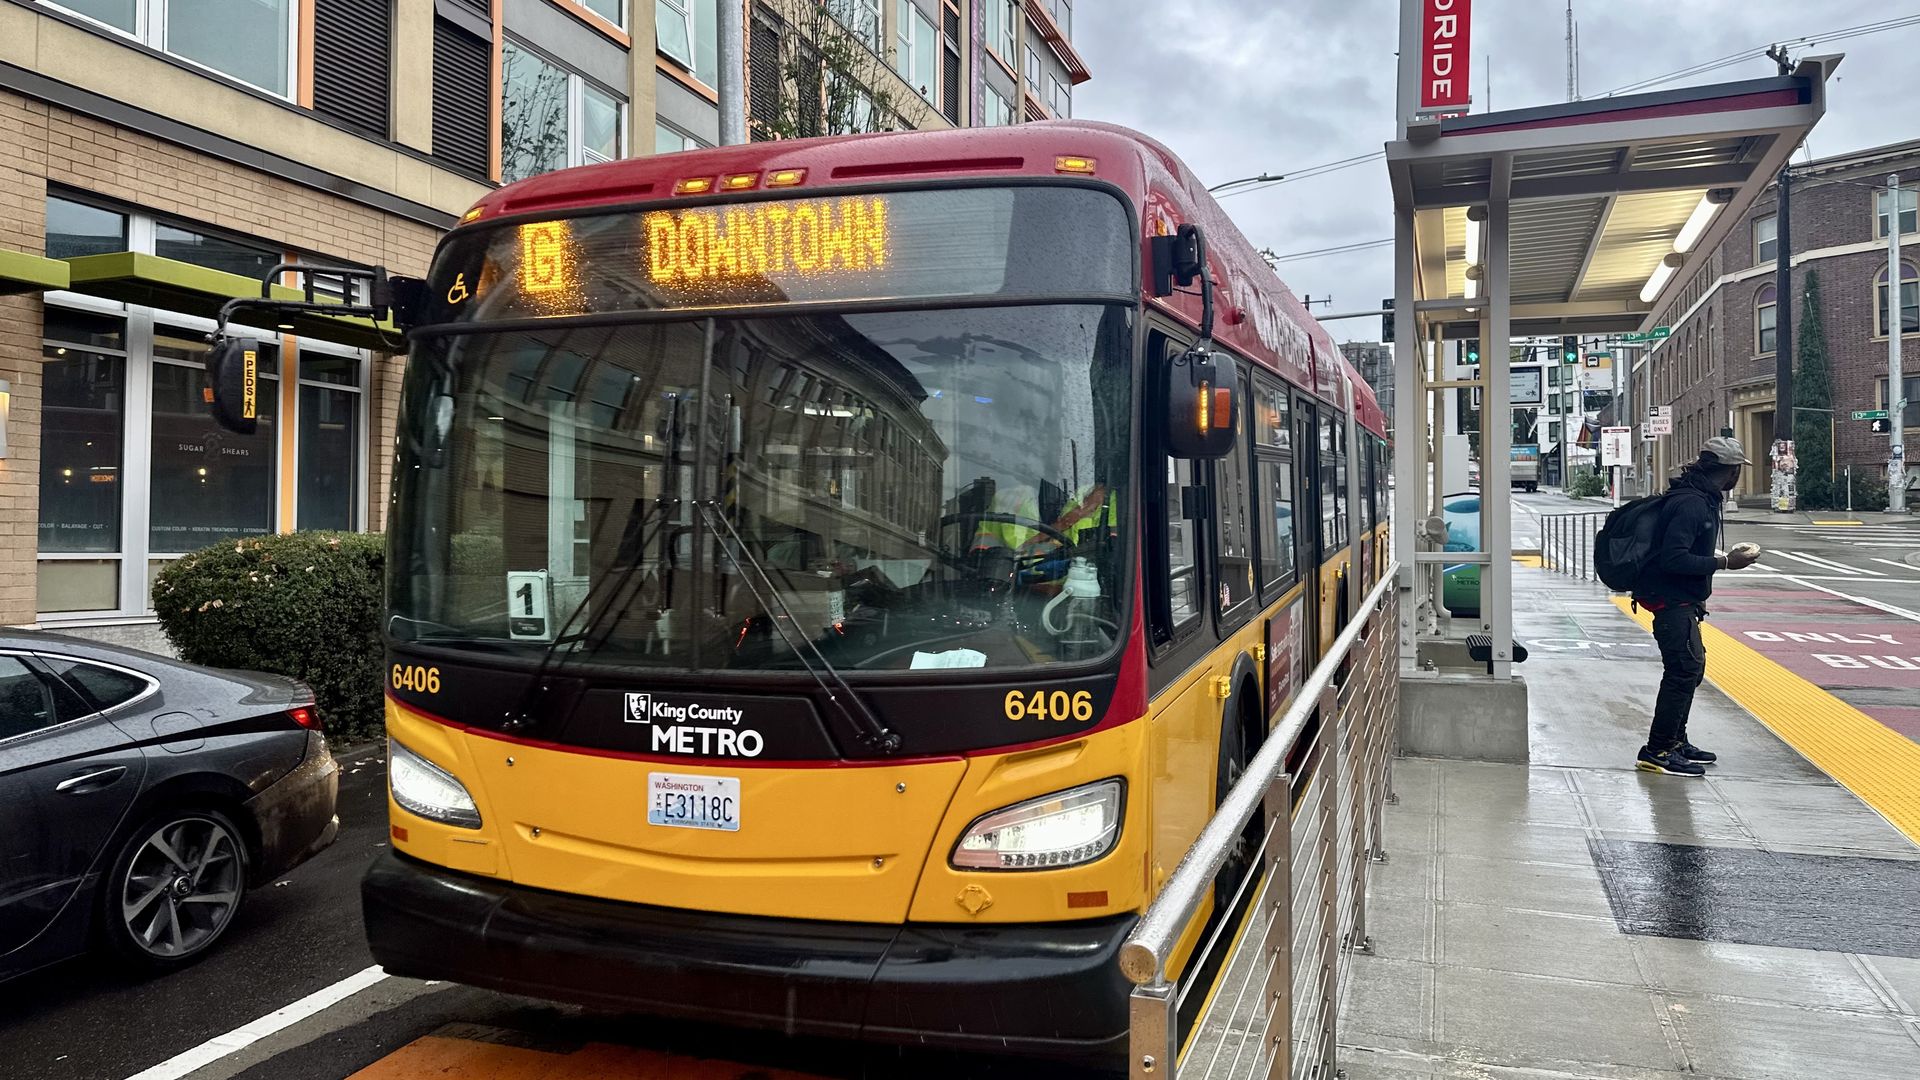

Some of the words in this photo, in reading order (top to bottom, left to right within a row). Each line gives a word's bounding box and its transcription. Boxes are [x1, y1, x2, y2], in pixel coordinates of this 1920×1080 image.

[648, 199, 886, 280] DOWNTOWN
[246, 360, 254, 396] PEDS
[178, 443, 204, 453] SUGAR
[221, 447, 250, 456] SHEARS
[516, 583, 533, 615] 1
[1743, 631, 1904, 645] ONLY
[1811, 653, 1920, 670] BU
[392, 663, 441, 694] 6406
[652, 702, 686, 723] King
[688, 703, 743, 725] County
[1004, 689, 1093, 721] 6406
[652, 724, 764, 757] METRO
[654, 782, 704, 792] WASHINGTON
[665, 793, 733, 822] E3118C
